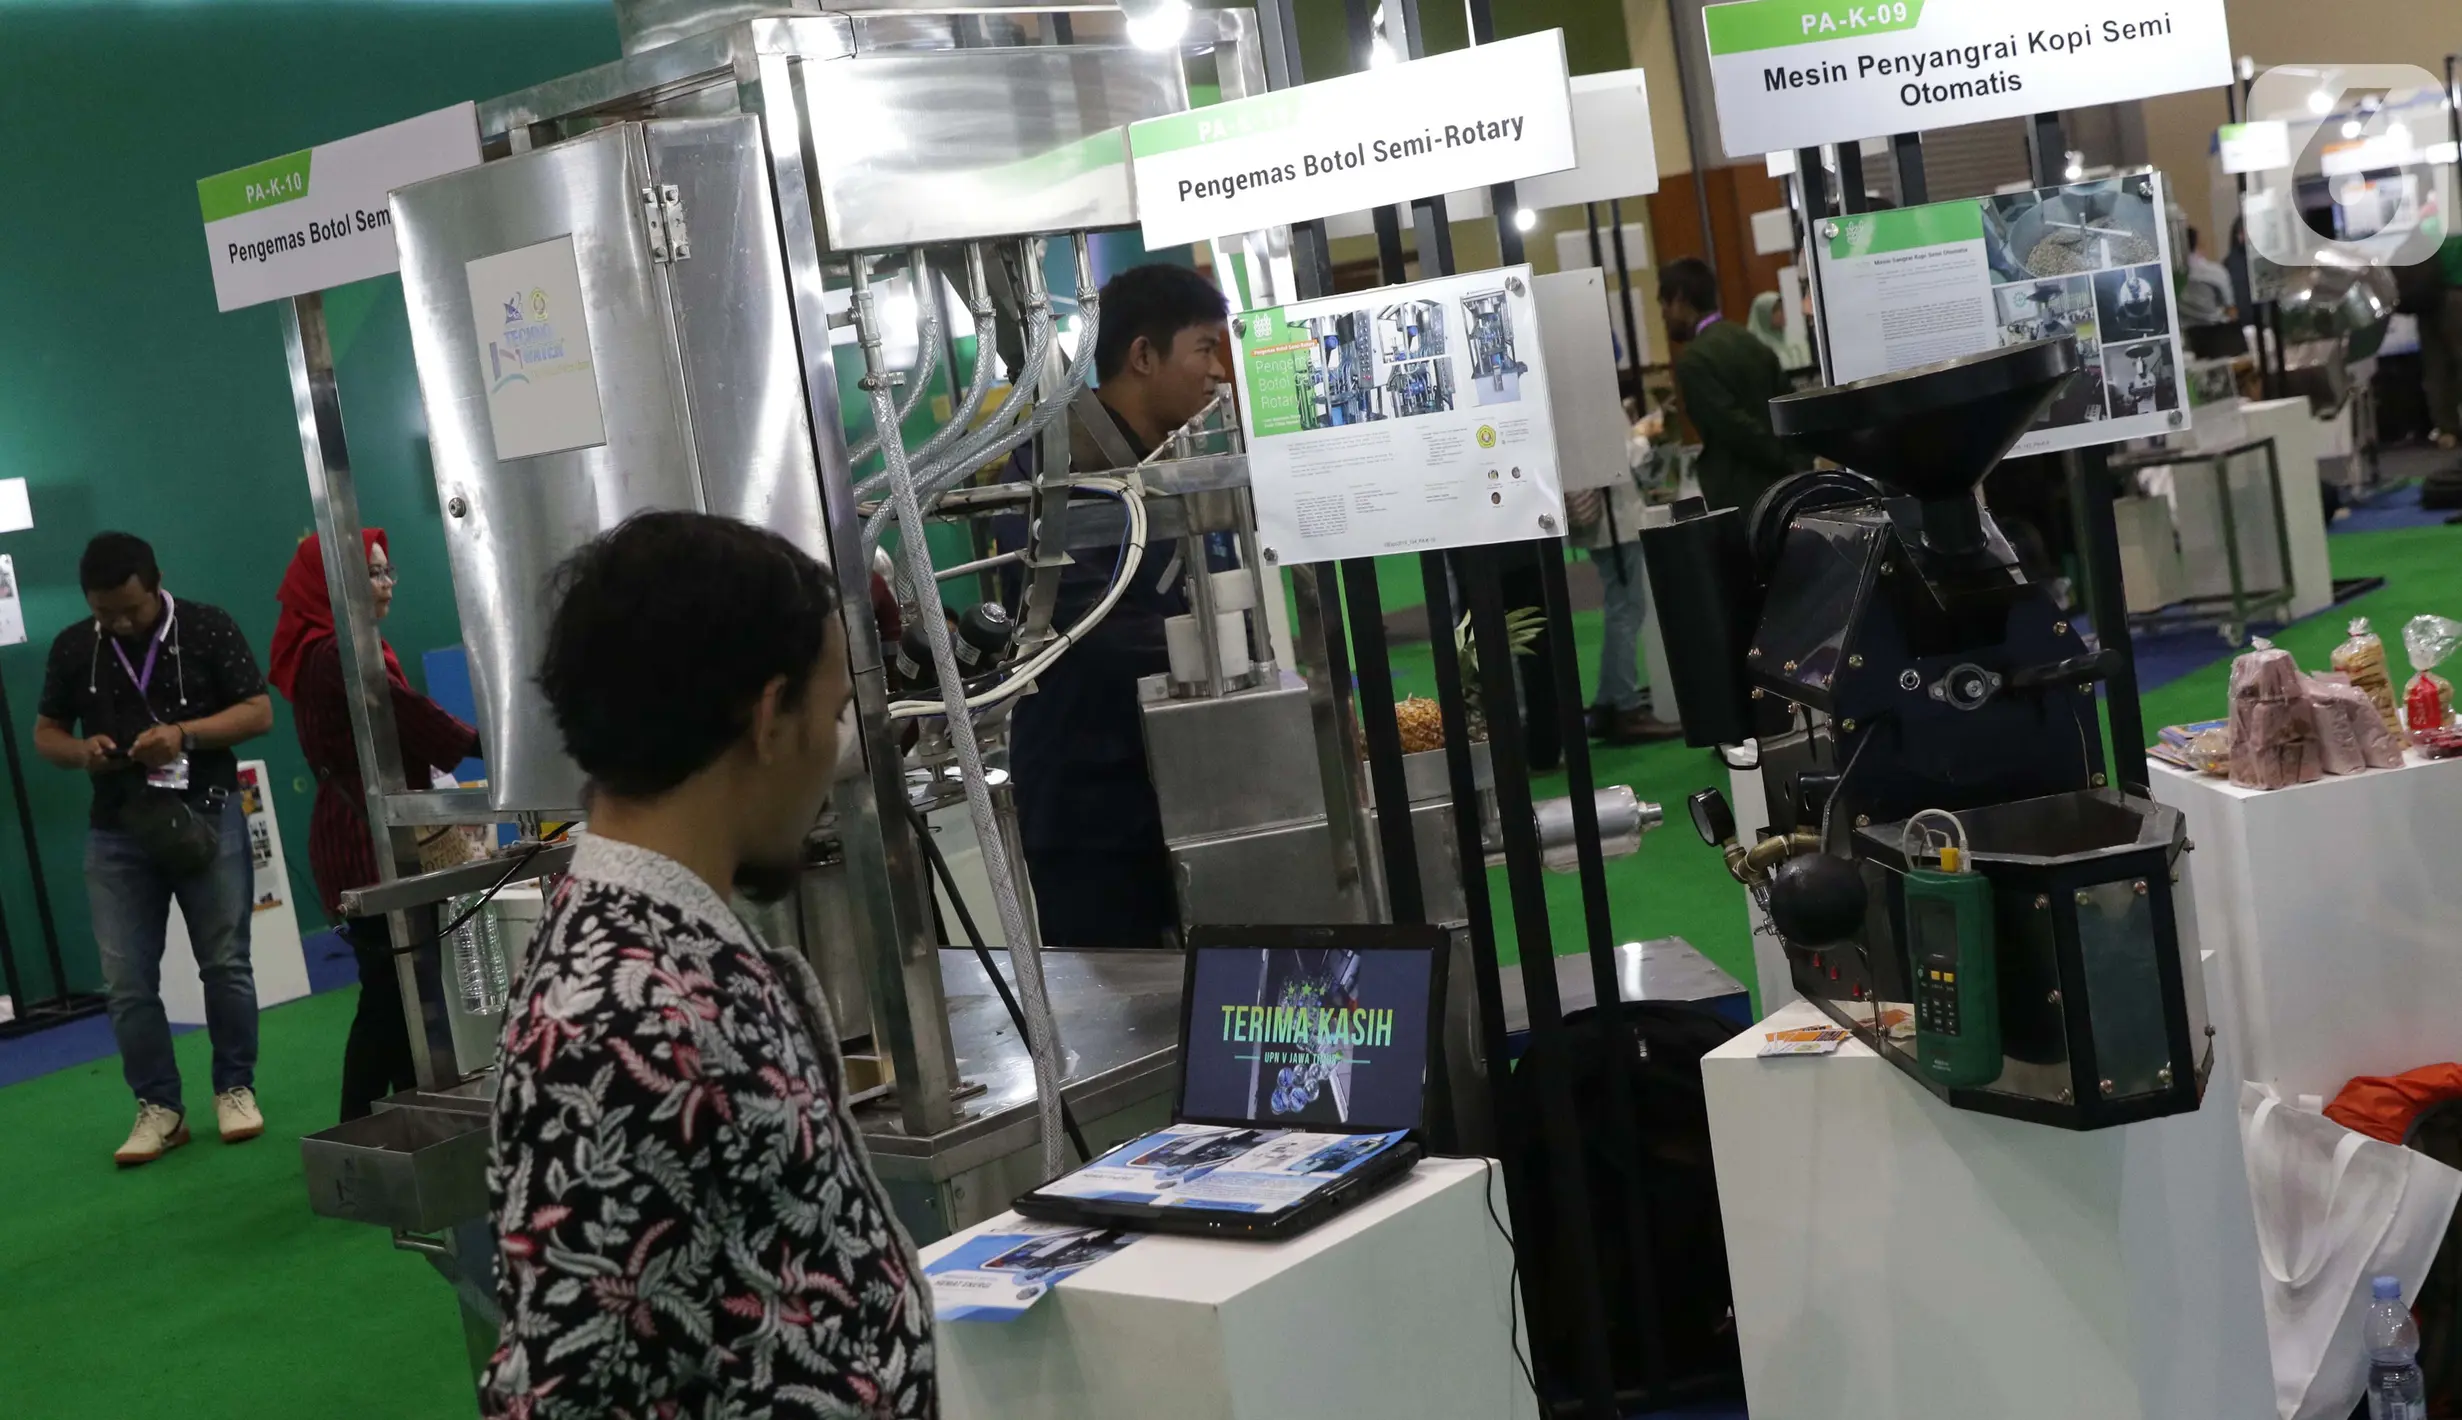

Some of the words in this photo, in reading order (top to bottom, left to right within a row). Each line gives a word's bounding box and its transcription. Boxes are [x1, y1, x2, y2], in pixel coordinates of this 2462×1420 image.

[1801, 1, 1908, 35] PA-K-09
[1763, 63, 1848, 93] Mesin
[1858, 35, 2018, 80] Penyangrai
[2028, 23, 2092, 56] Kopi
[2102, 12, 2173, 44] Semi
[1900, 71, 2023, 107] Otomatis
[1178, 162, 1296, 202] Pengemas
[1303, 142, 1366, 177] Botol
[1373, 114, 1525, 163] Semi-Rotary
[245, 171, 303, 204] PA-K-10
[228, 229, 306, 264] Pengemas
[308, 213, 352, 245] Botol
[355, 207, 391, 233] Sem
[1221, 1004, 1309, 1045] TERIMA
[1318, 1007, 1393, 1047] KASIH
[1264, 1051, 1280, 1063] UPN
[1281, 1052, 1288, 1063] V
[1289, 1052, 1310, 1065] JAWA
